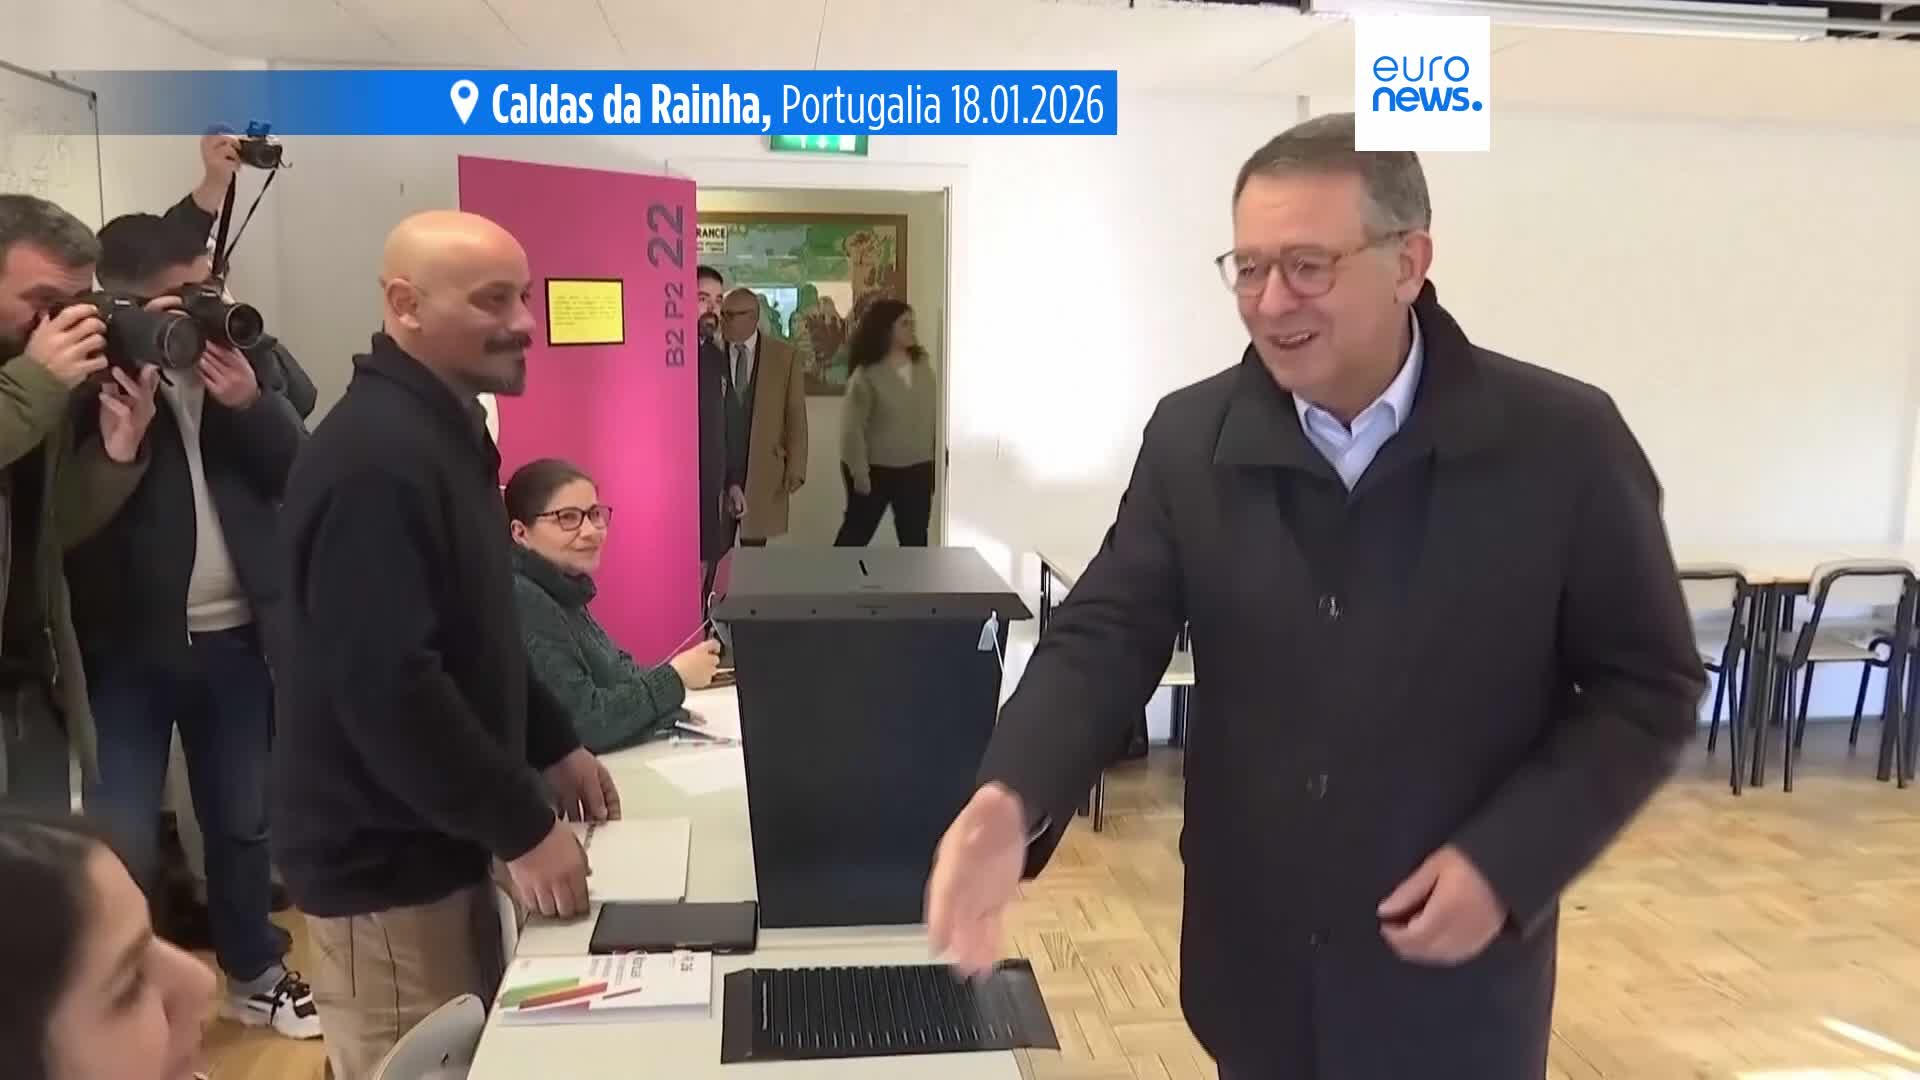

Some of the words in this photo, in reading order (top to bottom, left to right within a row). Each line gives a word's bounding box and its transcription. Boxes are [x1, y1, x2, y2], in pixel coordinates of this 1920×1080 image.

[646, 202, 684, 269] 22
[664, 281, 684, 319] P2
[665, 328, 685, 368] B2
